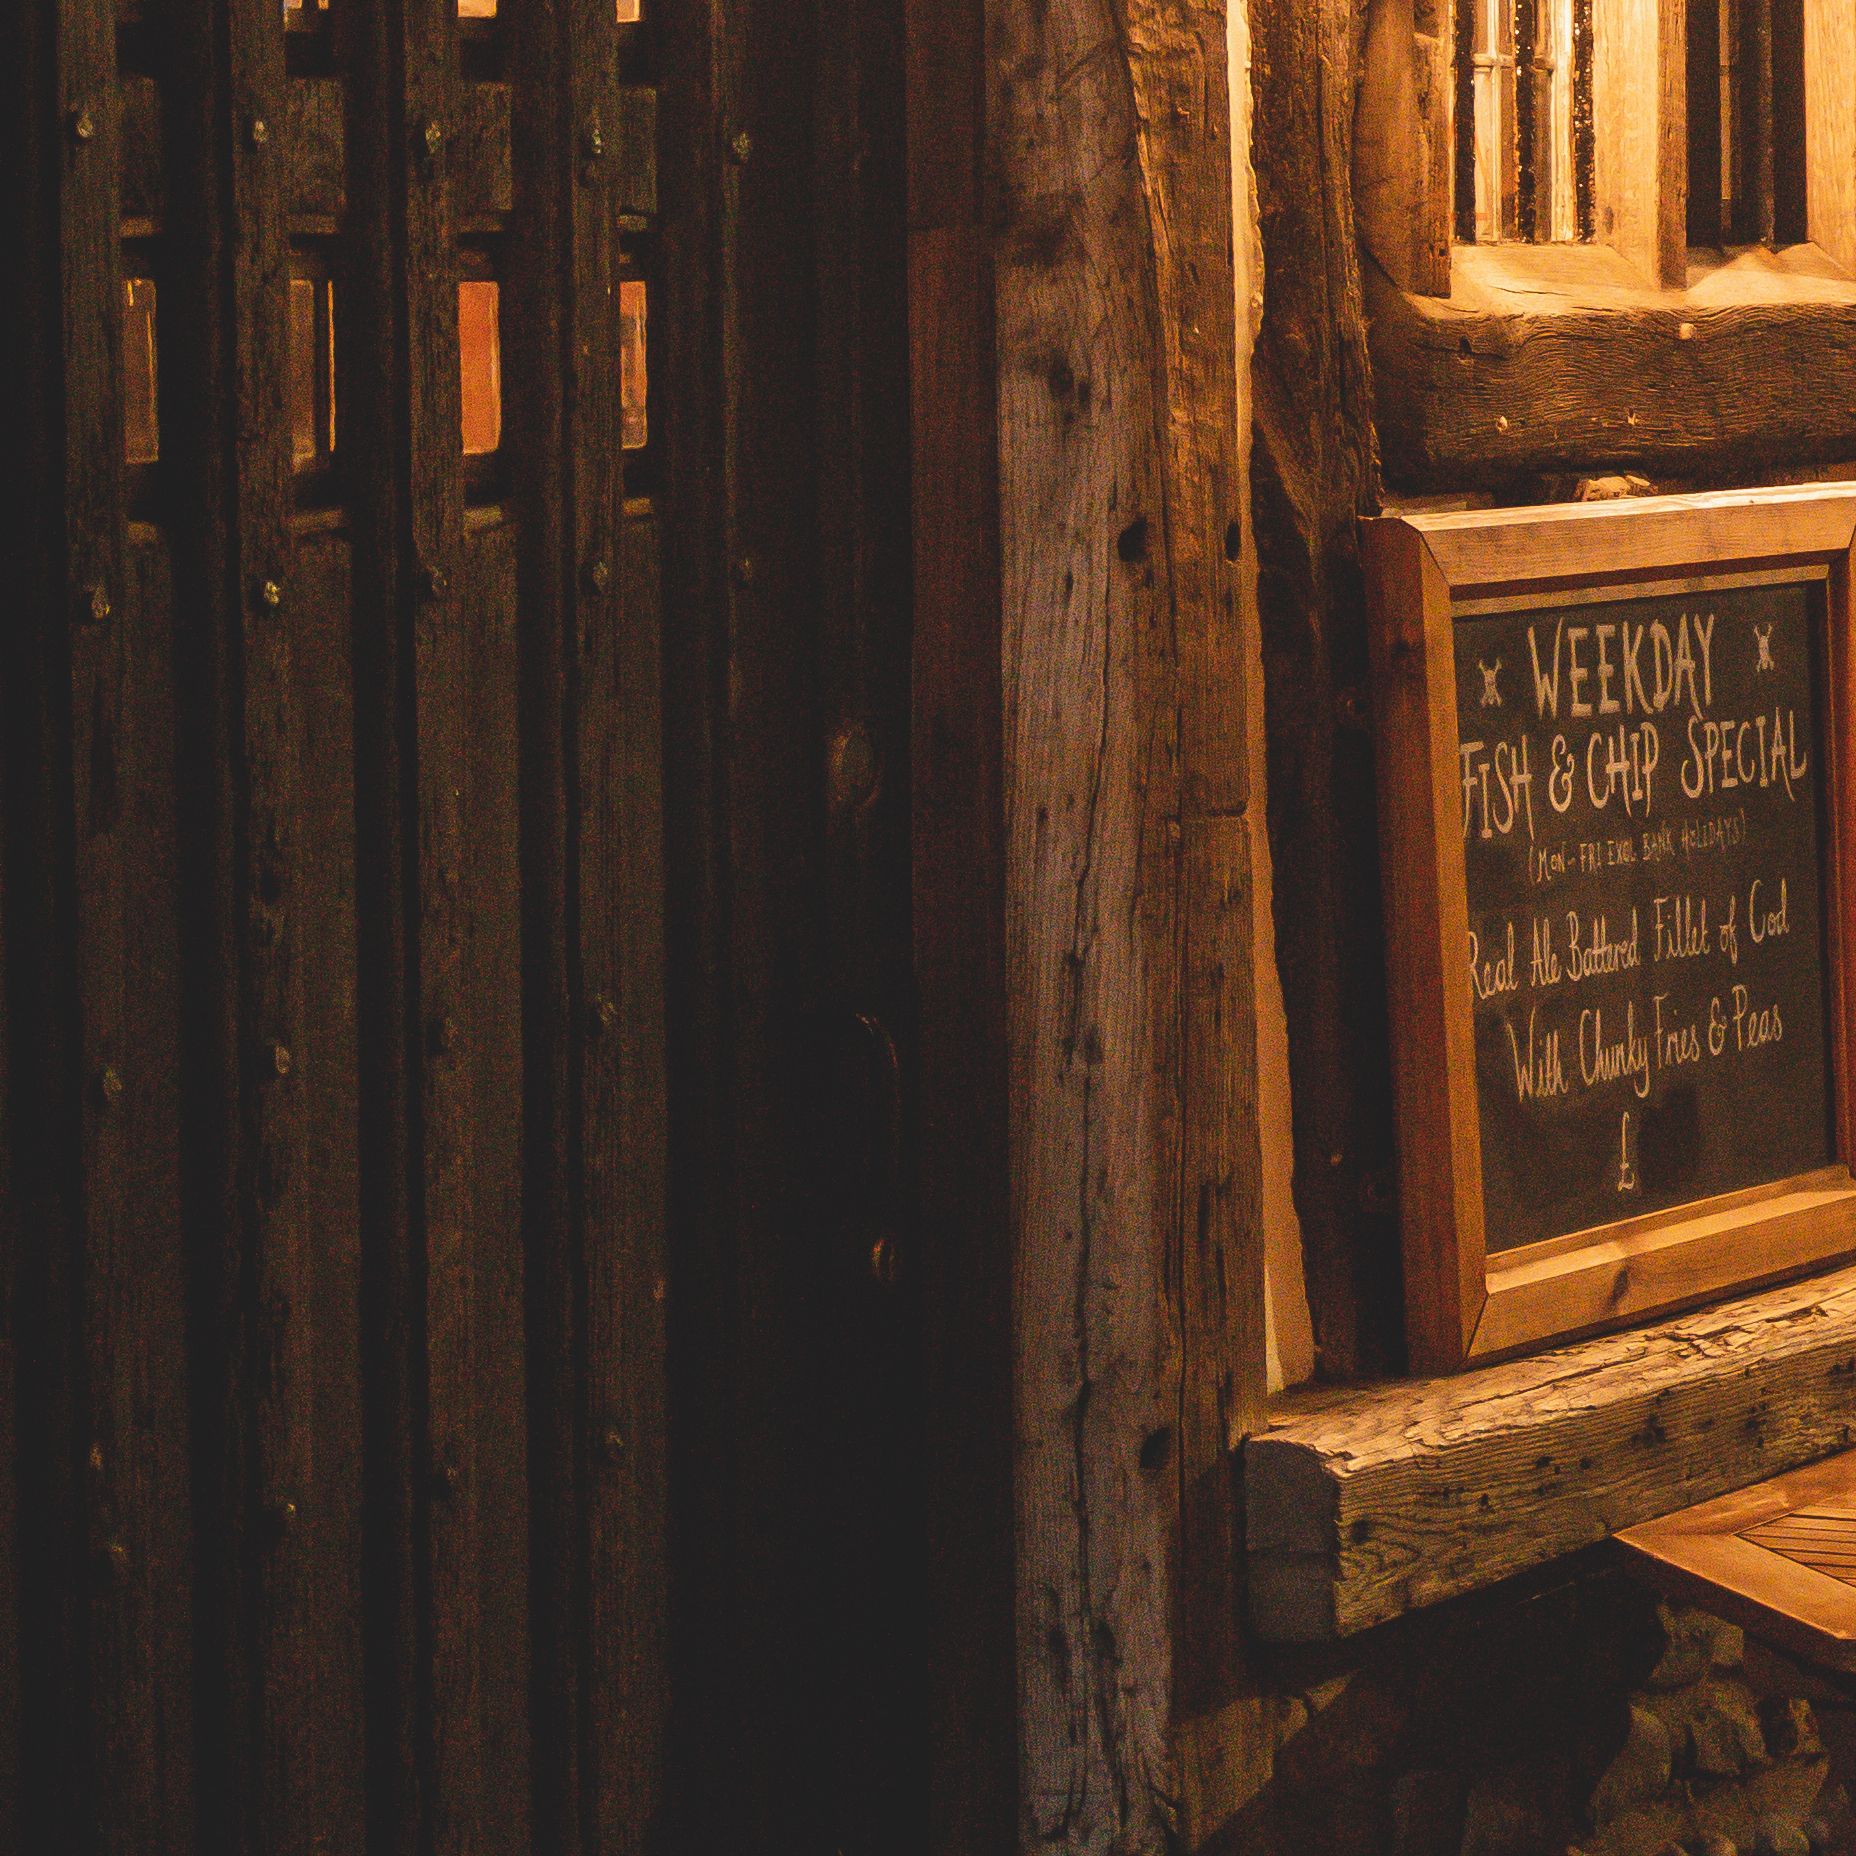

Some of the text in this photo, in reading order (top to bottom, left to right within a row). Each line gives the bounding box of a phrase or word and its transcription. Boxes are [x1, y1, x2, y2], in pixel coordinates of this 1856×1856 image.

[1527, 613, 1715, 720] WEEKDAY
[1460, 706, 1808, 840] FISH & CHIP SPECIAL
[1468, 878, 1789, 1000] Real Ale Battered Fillet of Cod
[1505, 984, 1783, 1103] With Chunky Fries & Peas
